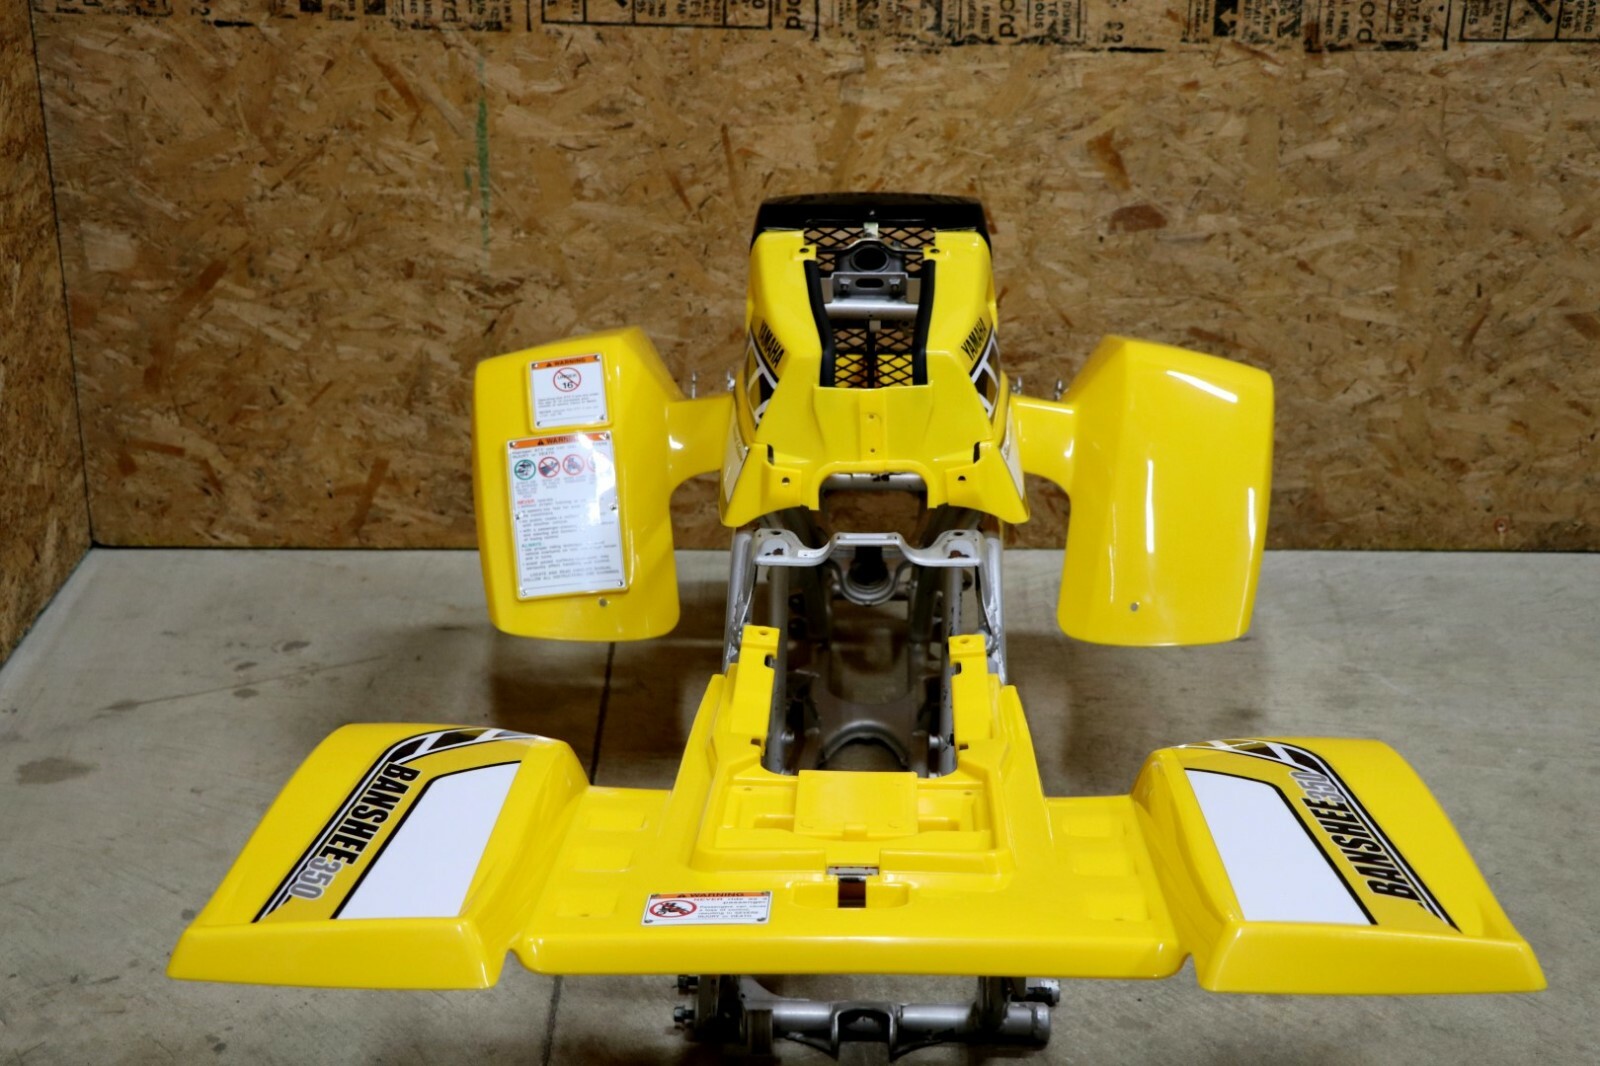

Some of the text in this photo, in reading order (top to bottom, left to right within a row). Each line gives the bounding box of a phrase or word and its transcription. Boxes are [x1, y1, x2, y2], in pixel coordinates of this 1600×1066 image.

[554, 357, 586, 366] WARNING
[758, 319, 786, 368] YAMAHA
[961, 316, 987, 362] YAMAHA
[562, 381, 574, 389] 16
[288, 761, 421, 901] BANSHEE 350
[1289, 770, 1422, 904] BANSHEE 350
